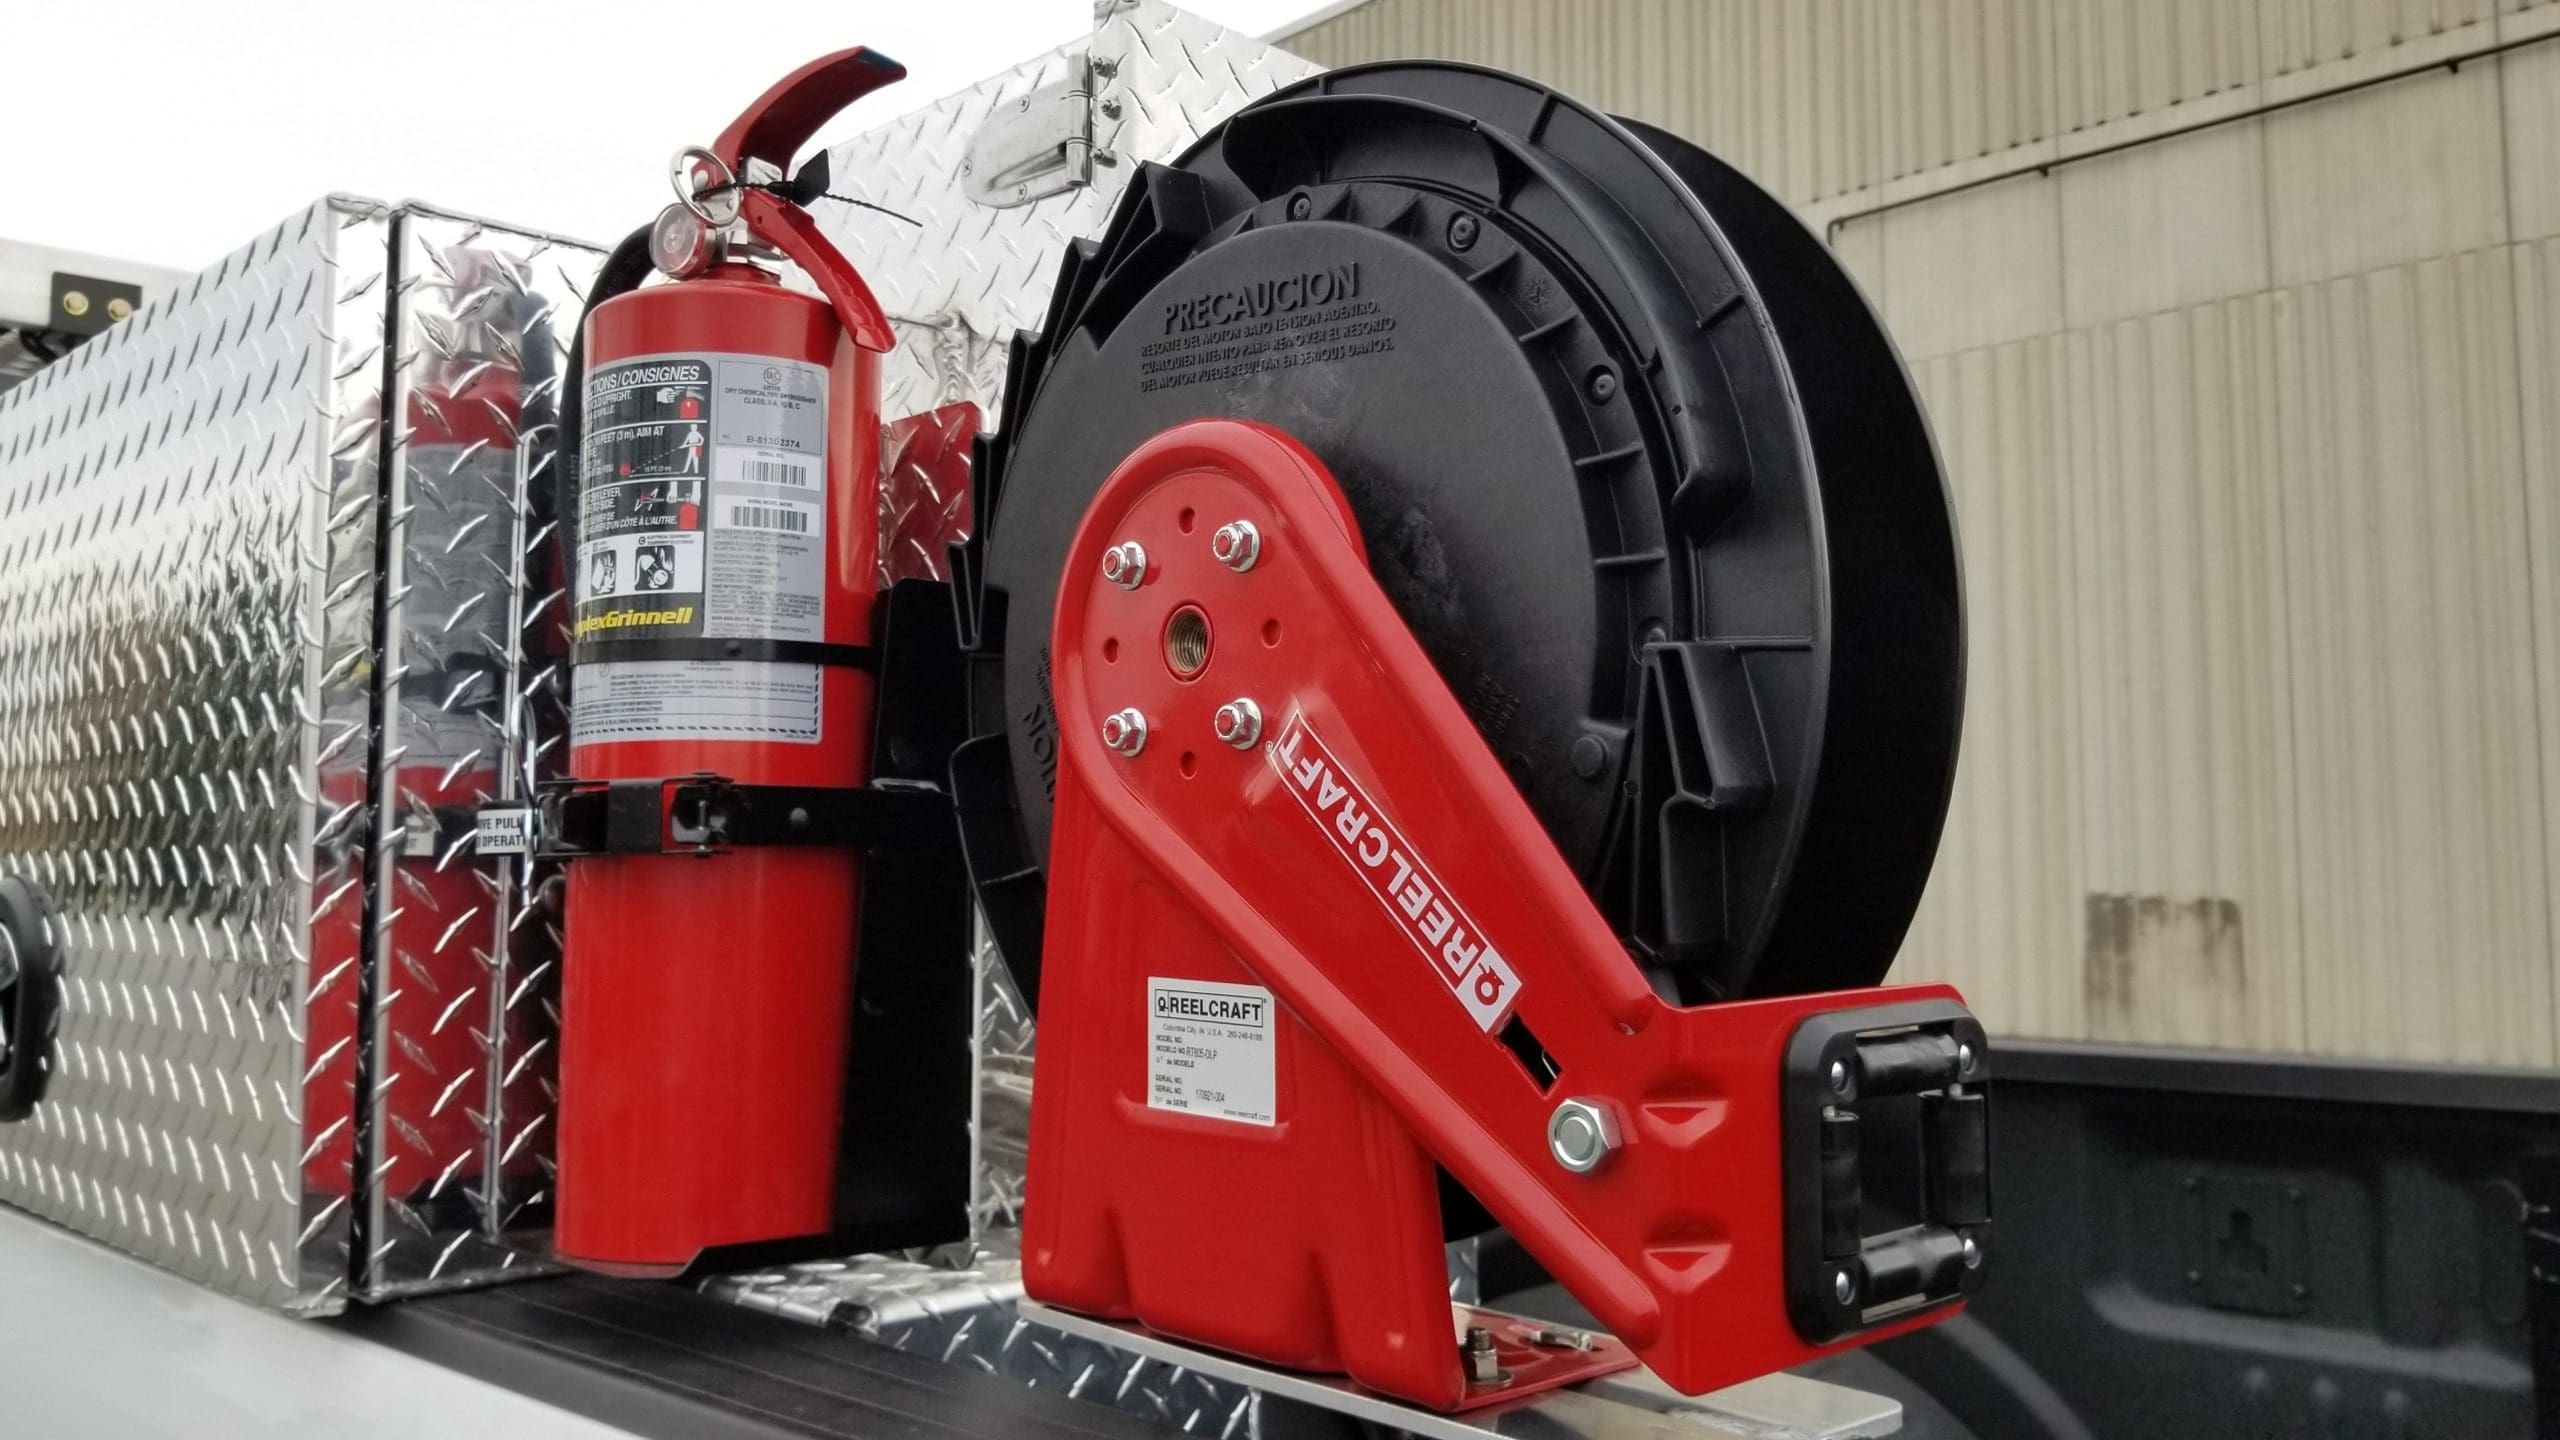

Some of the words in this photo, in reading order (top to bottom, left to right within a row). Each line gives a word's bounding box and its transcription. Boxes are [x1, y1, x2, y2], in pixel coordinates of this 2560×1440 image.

[1164, 262, 1360, 335] PRECAUCION
[1278, 730, 1479, 978] REELCRAFT
[1170, 997, 1261, 1020] REELCRAFT
